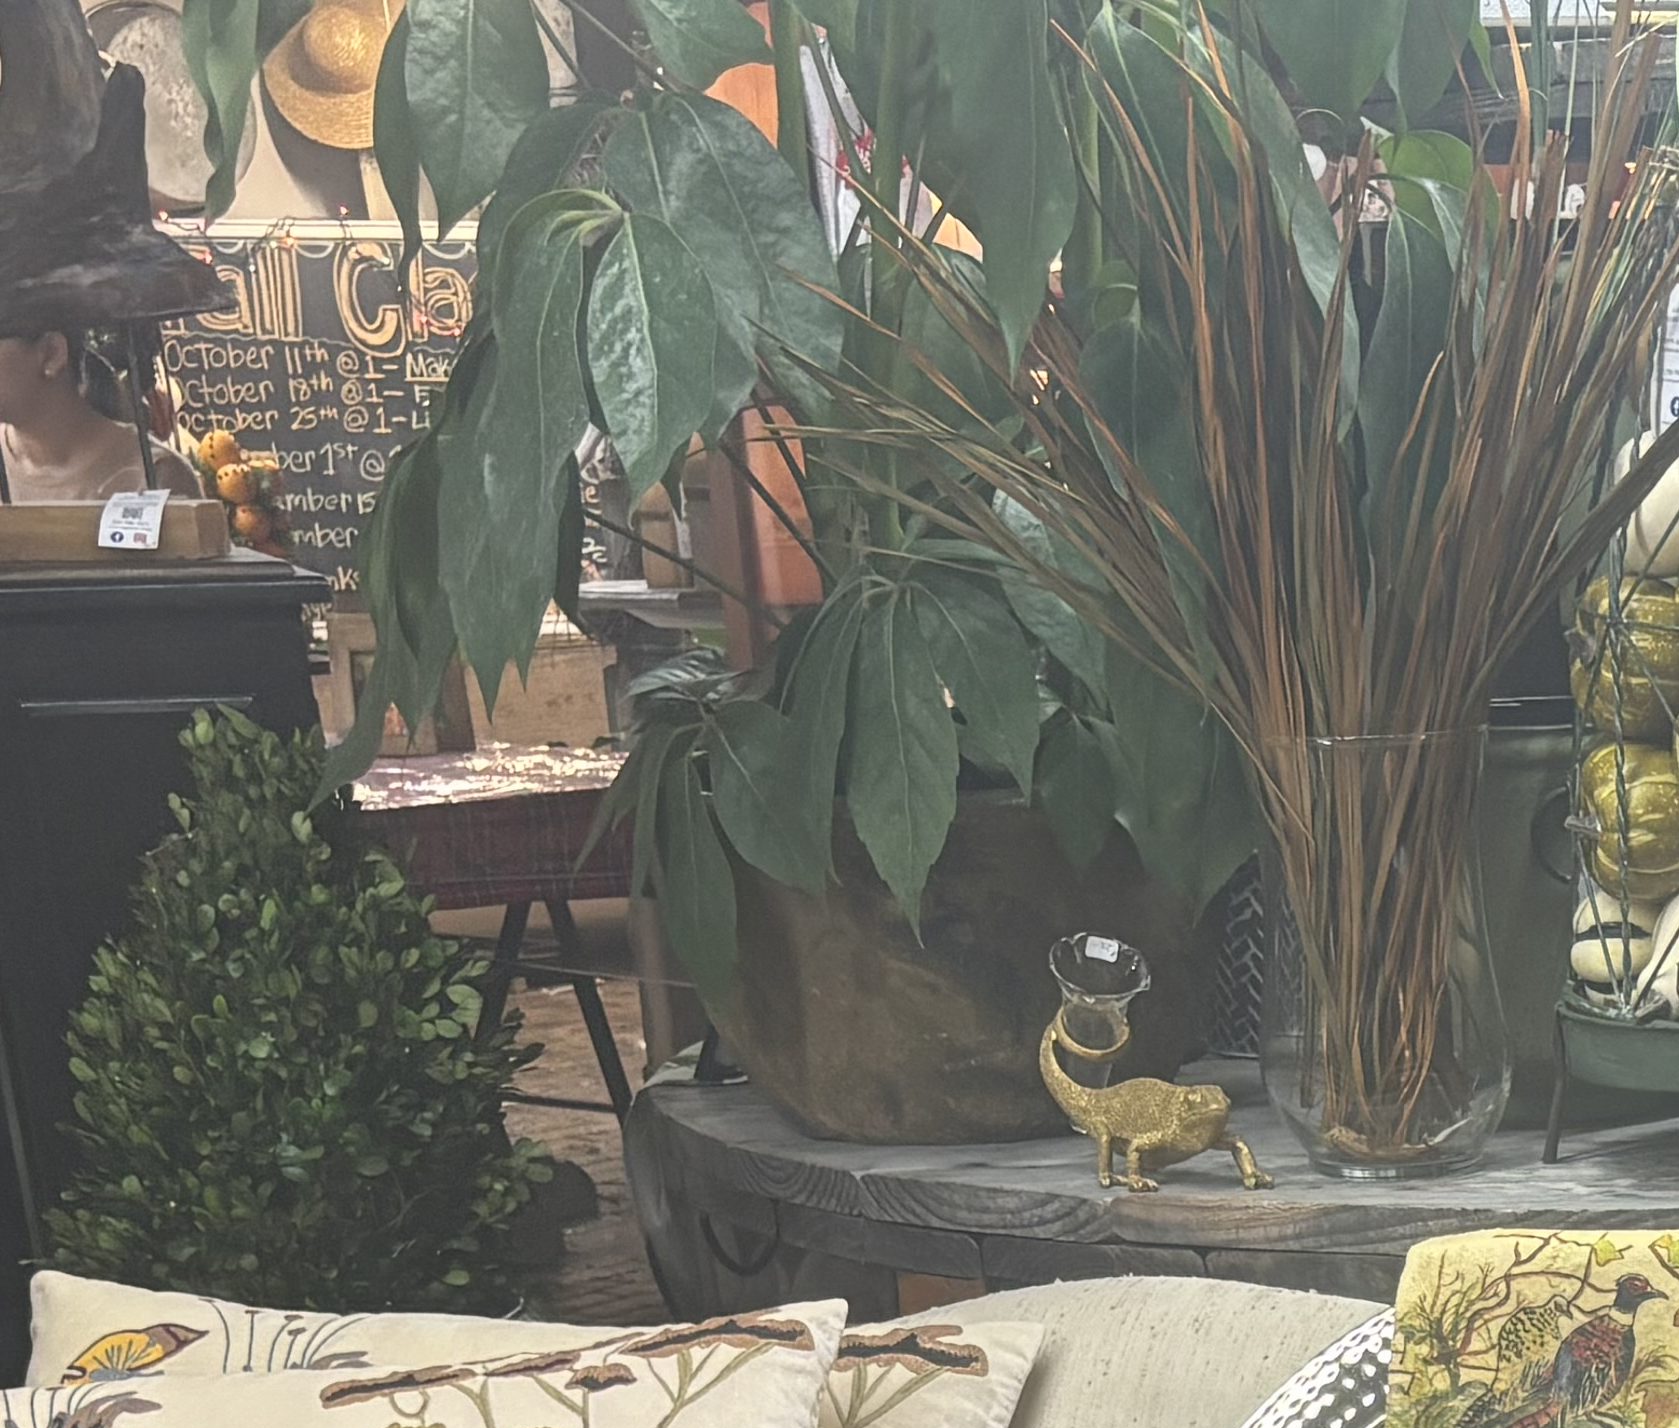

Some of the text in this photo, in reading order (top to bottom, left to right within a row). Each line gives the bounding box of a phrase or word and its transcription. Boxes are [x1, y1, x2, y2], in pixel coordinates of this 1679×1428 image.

[160, 243, 303, 342] all
[163, 340, 275, 373] October
[336, 352, 360, 378] @
[341, 382, 364, 405] @
[177, 406, 369, 434] October 25th @
